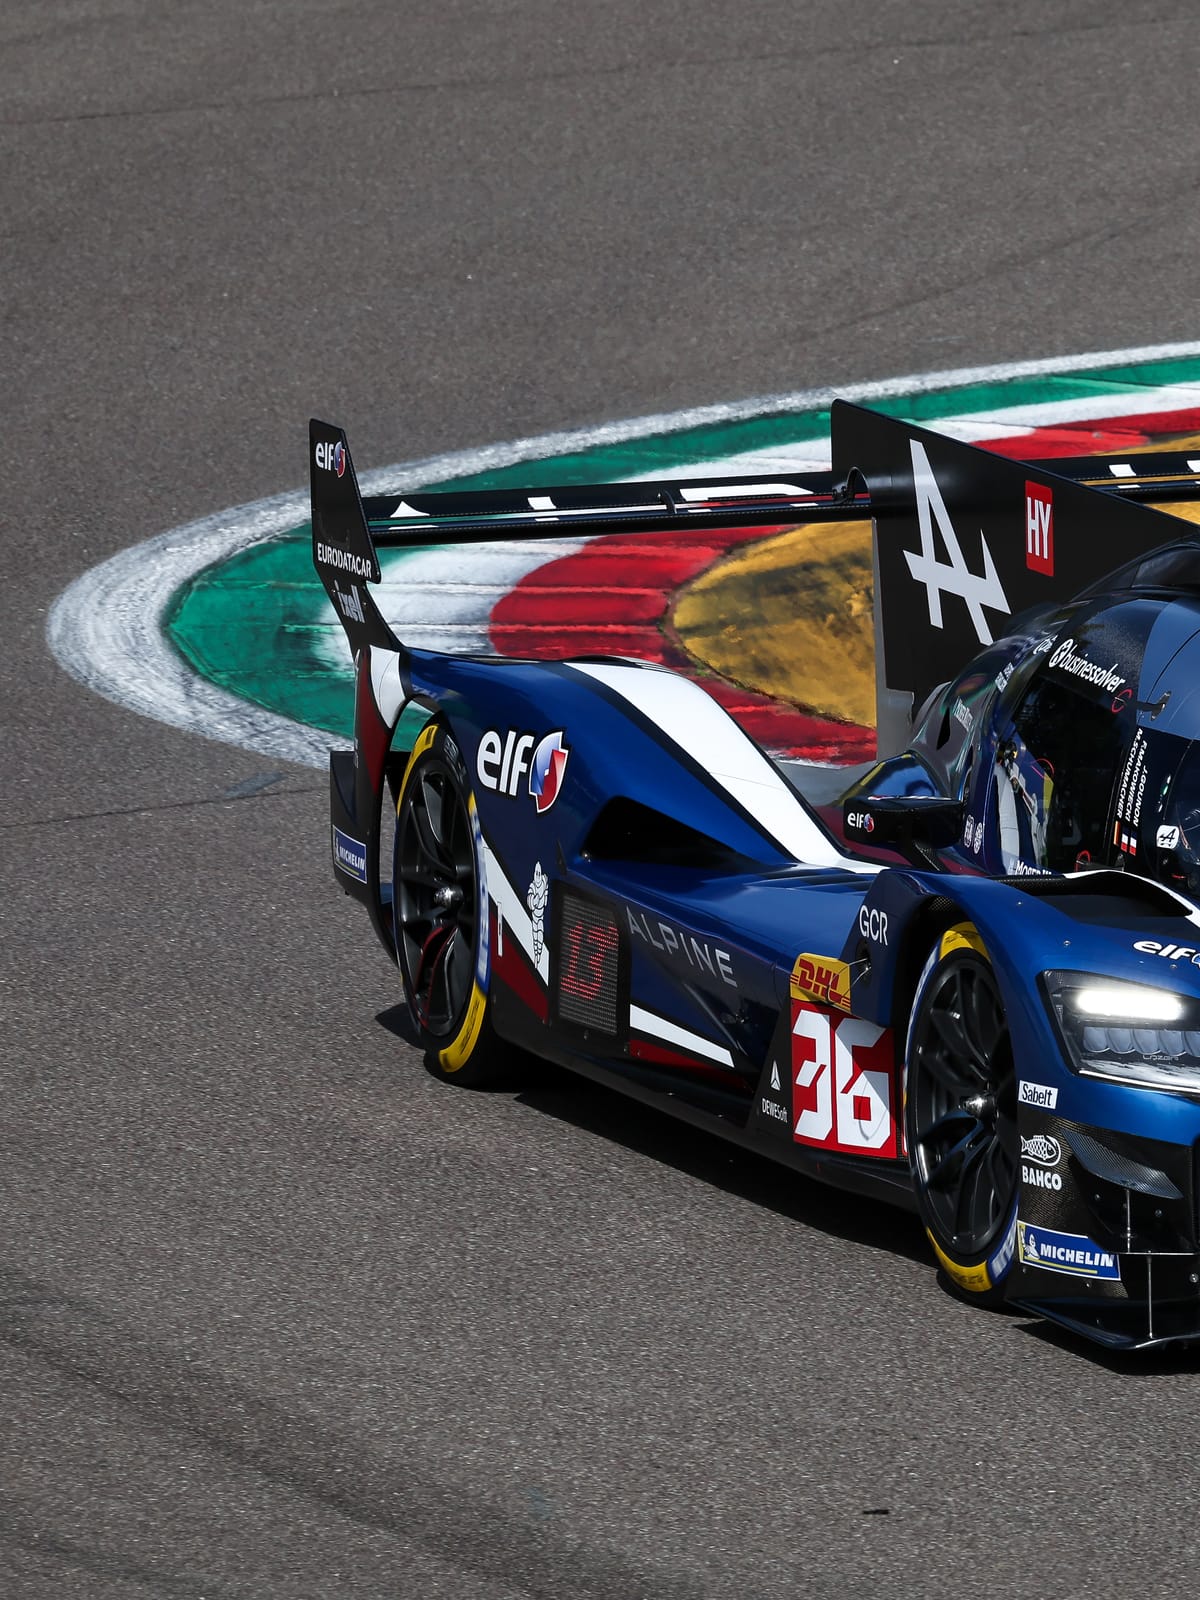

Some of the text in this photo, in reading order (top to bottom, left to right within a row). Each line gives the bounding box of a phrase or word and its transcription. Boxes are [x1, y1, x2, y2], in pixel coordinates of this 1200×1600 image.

[315, 441, 334, 471] elf
[1027, 497, 1051, 559] HY
[317, 542, 372, 579] EURODATACAR
[1059, 646, 1127, 693] businessolver
[477, 730, 535, 796] elf
[1117, 728, 1143, 819] M.SCHUMACHER
[1133, 765, 1148, 827] J.GOUNON
[847, 812, 864, 828] elf
[340, 847, 364, 870] MICHELIN
[859, 904, 888, 945] GCR
[626, 906, 737, 988] ALPINE
[1133, 940, 1194, 961] elf
[797, 959, 843, 1004] DHL
[793, 1009, 891, 1149] 36
[1022, 1083, 1053, 1106] Sabelt
[1022, 1165, 1062, 1191] BAHCO
[1040, 1242, 1115, 1267] MICHELIN
